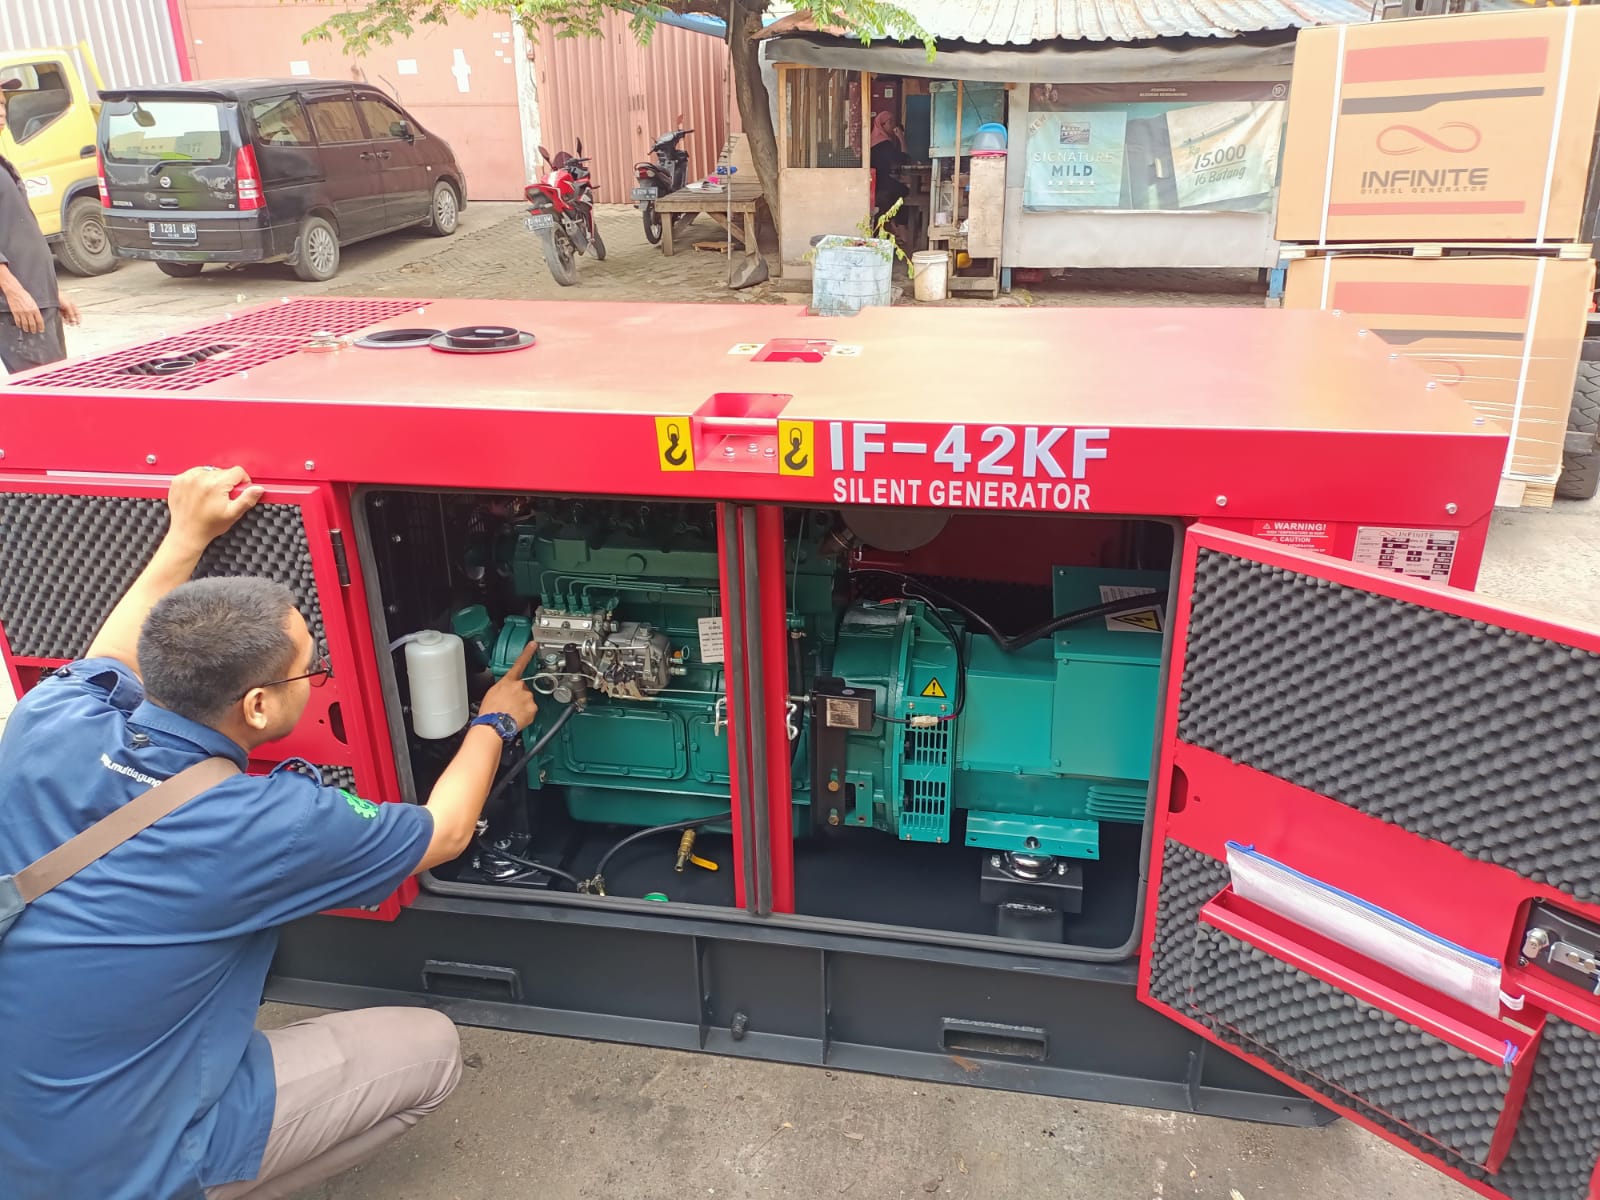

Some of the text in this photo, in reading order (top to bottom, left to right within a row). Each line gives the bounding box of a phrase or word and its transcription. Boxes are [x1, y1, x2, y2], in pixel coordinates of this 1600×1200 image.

[1033, 151, 1113, 163] SIGNATURE
[1194, 144, 1247, 169] 15.000
[1051, 165, 1093, 177] MILD
[1194, 166, 1247, 186] 16 Batang
[1361, 167, 1489, 188] INFINITE
[1411, 186, 1488, 194] GENERATOR
[829, 421, 1111, 480] IF-42KF
[833, 476, 1091, 510] SILENT GENERATOR
[1274, 521, 1327, 531] WARNING!
